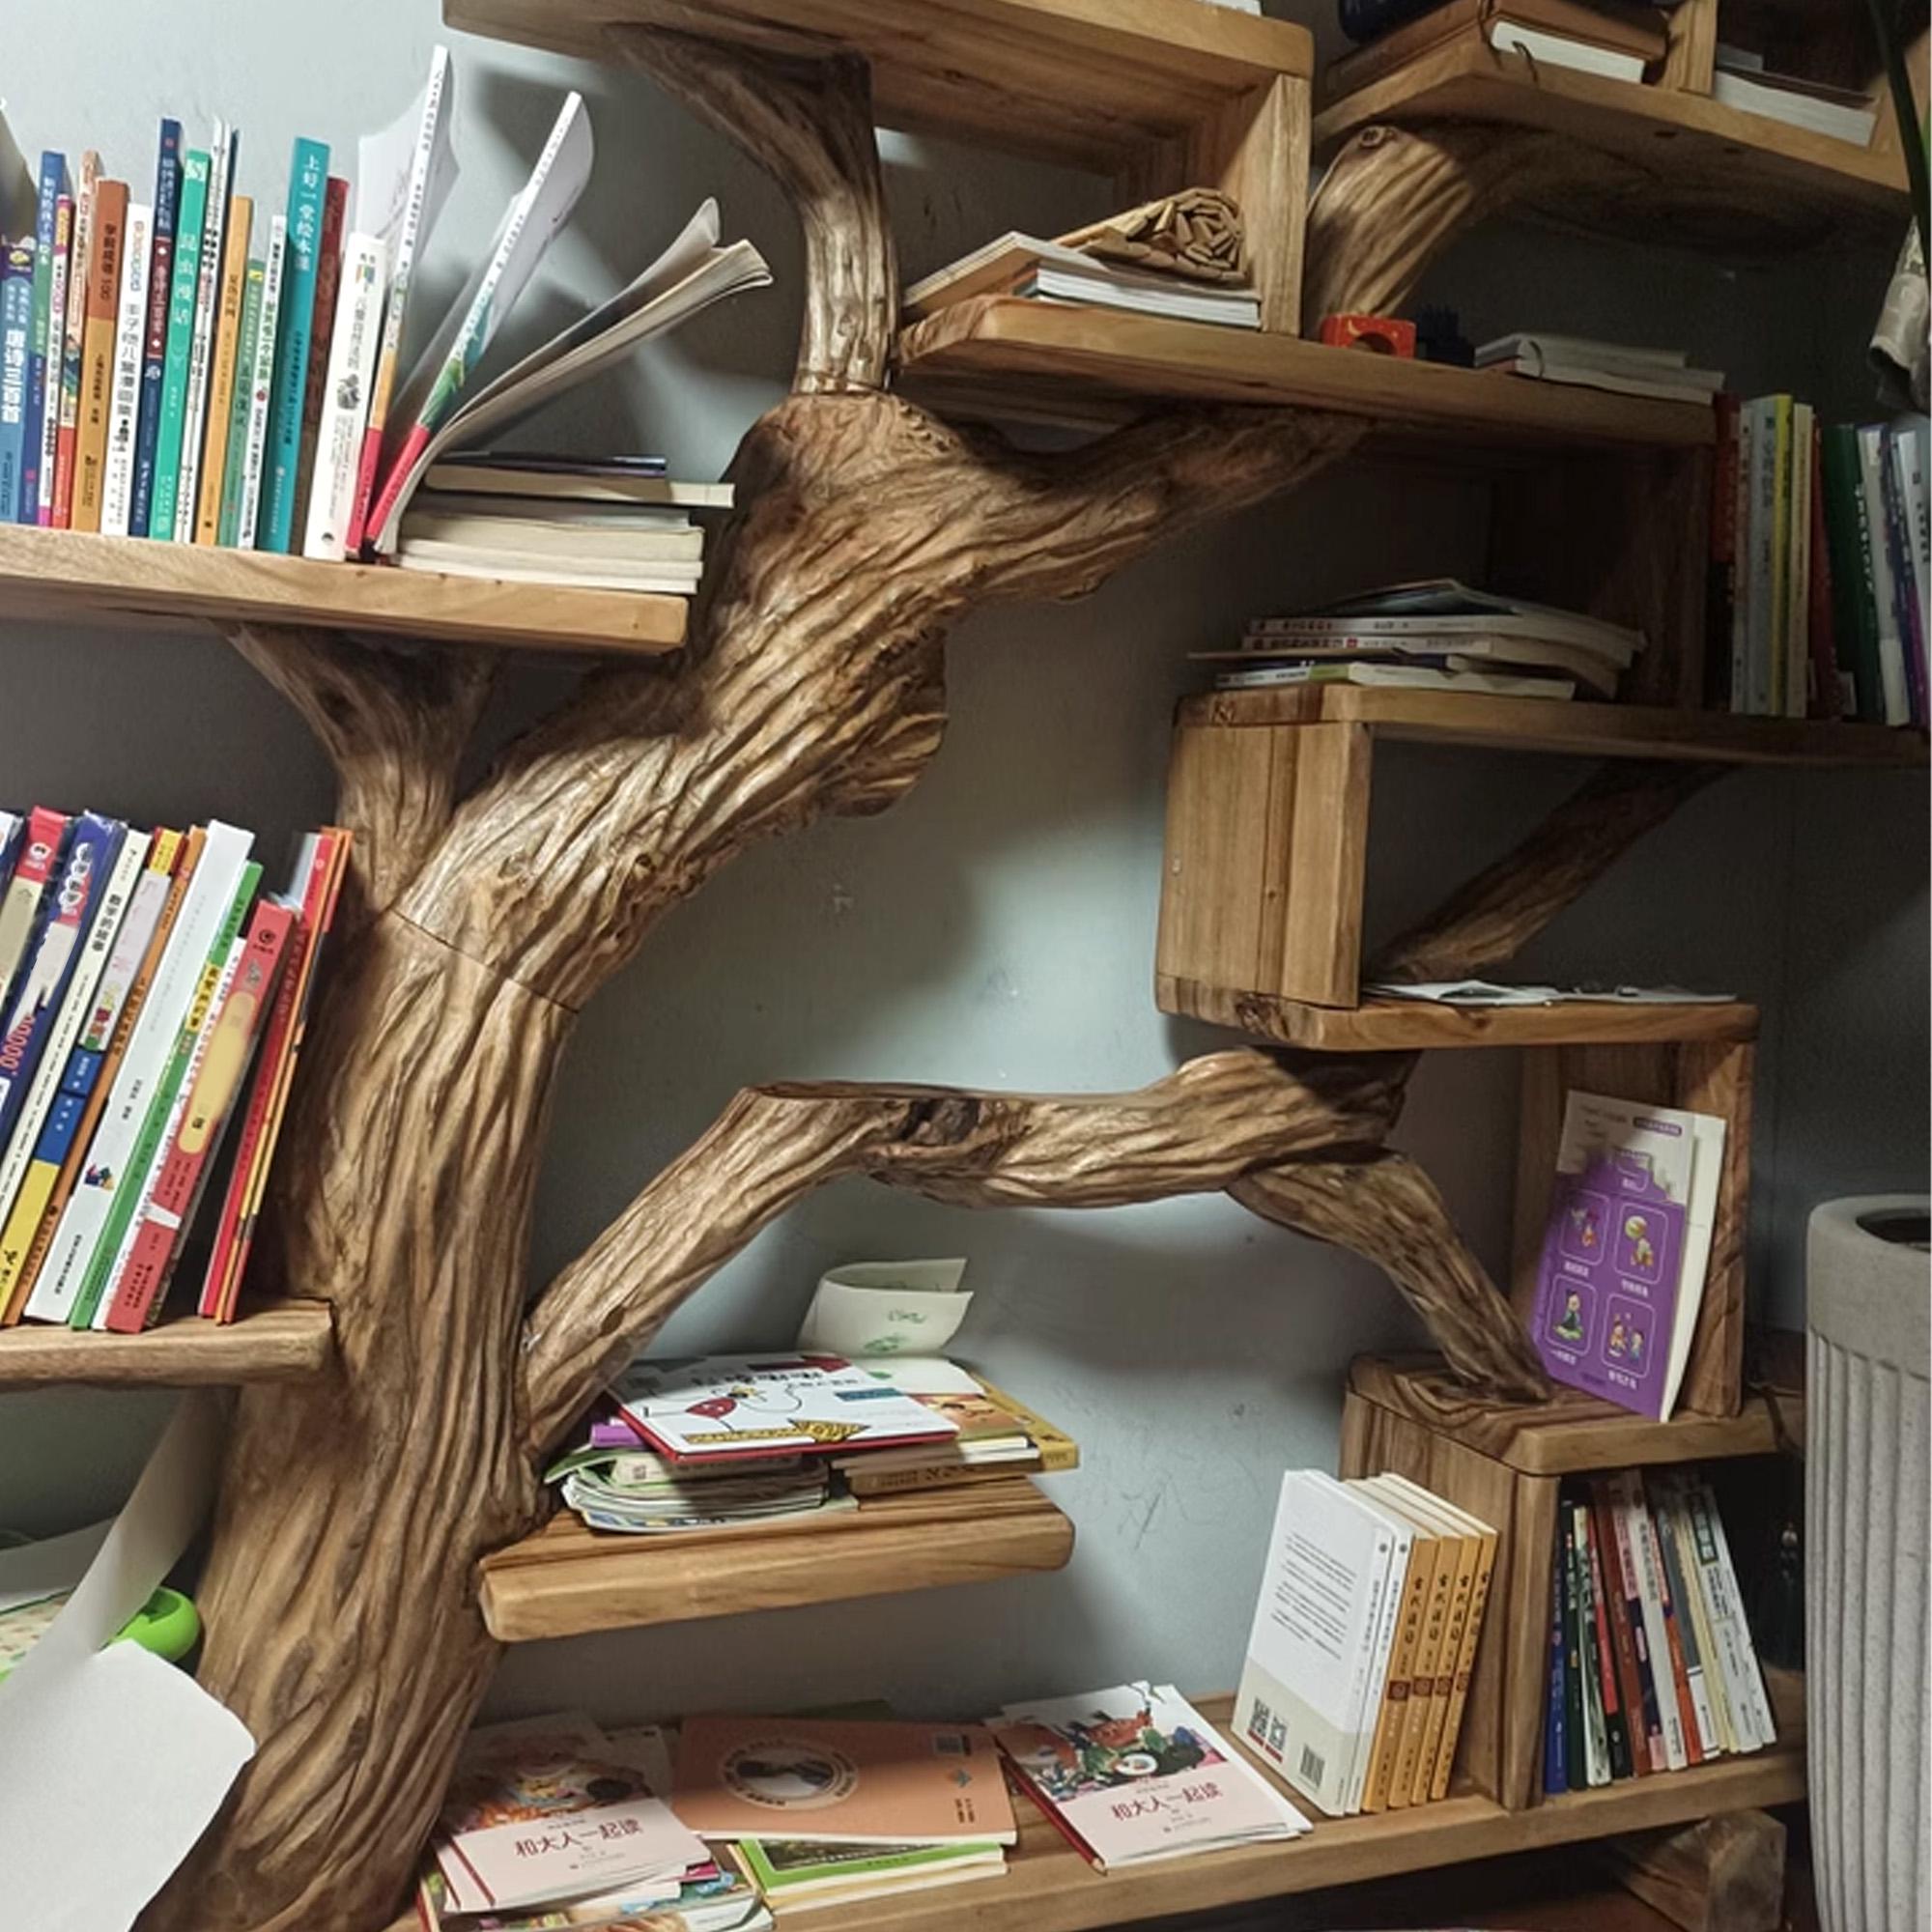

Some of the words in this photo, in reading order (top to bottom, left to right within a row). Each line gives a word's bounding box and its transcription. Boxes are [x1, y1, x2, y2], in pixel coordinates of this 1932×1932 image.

[1112, 1782, 1223, 1821] 和大人一起读
[515, 1818, 643, 1858] 和大人一起读
